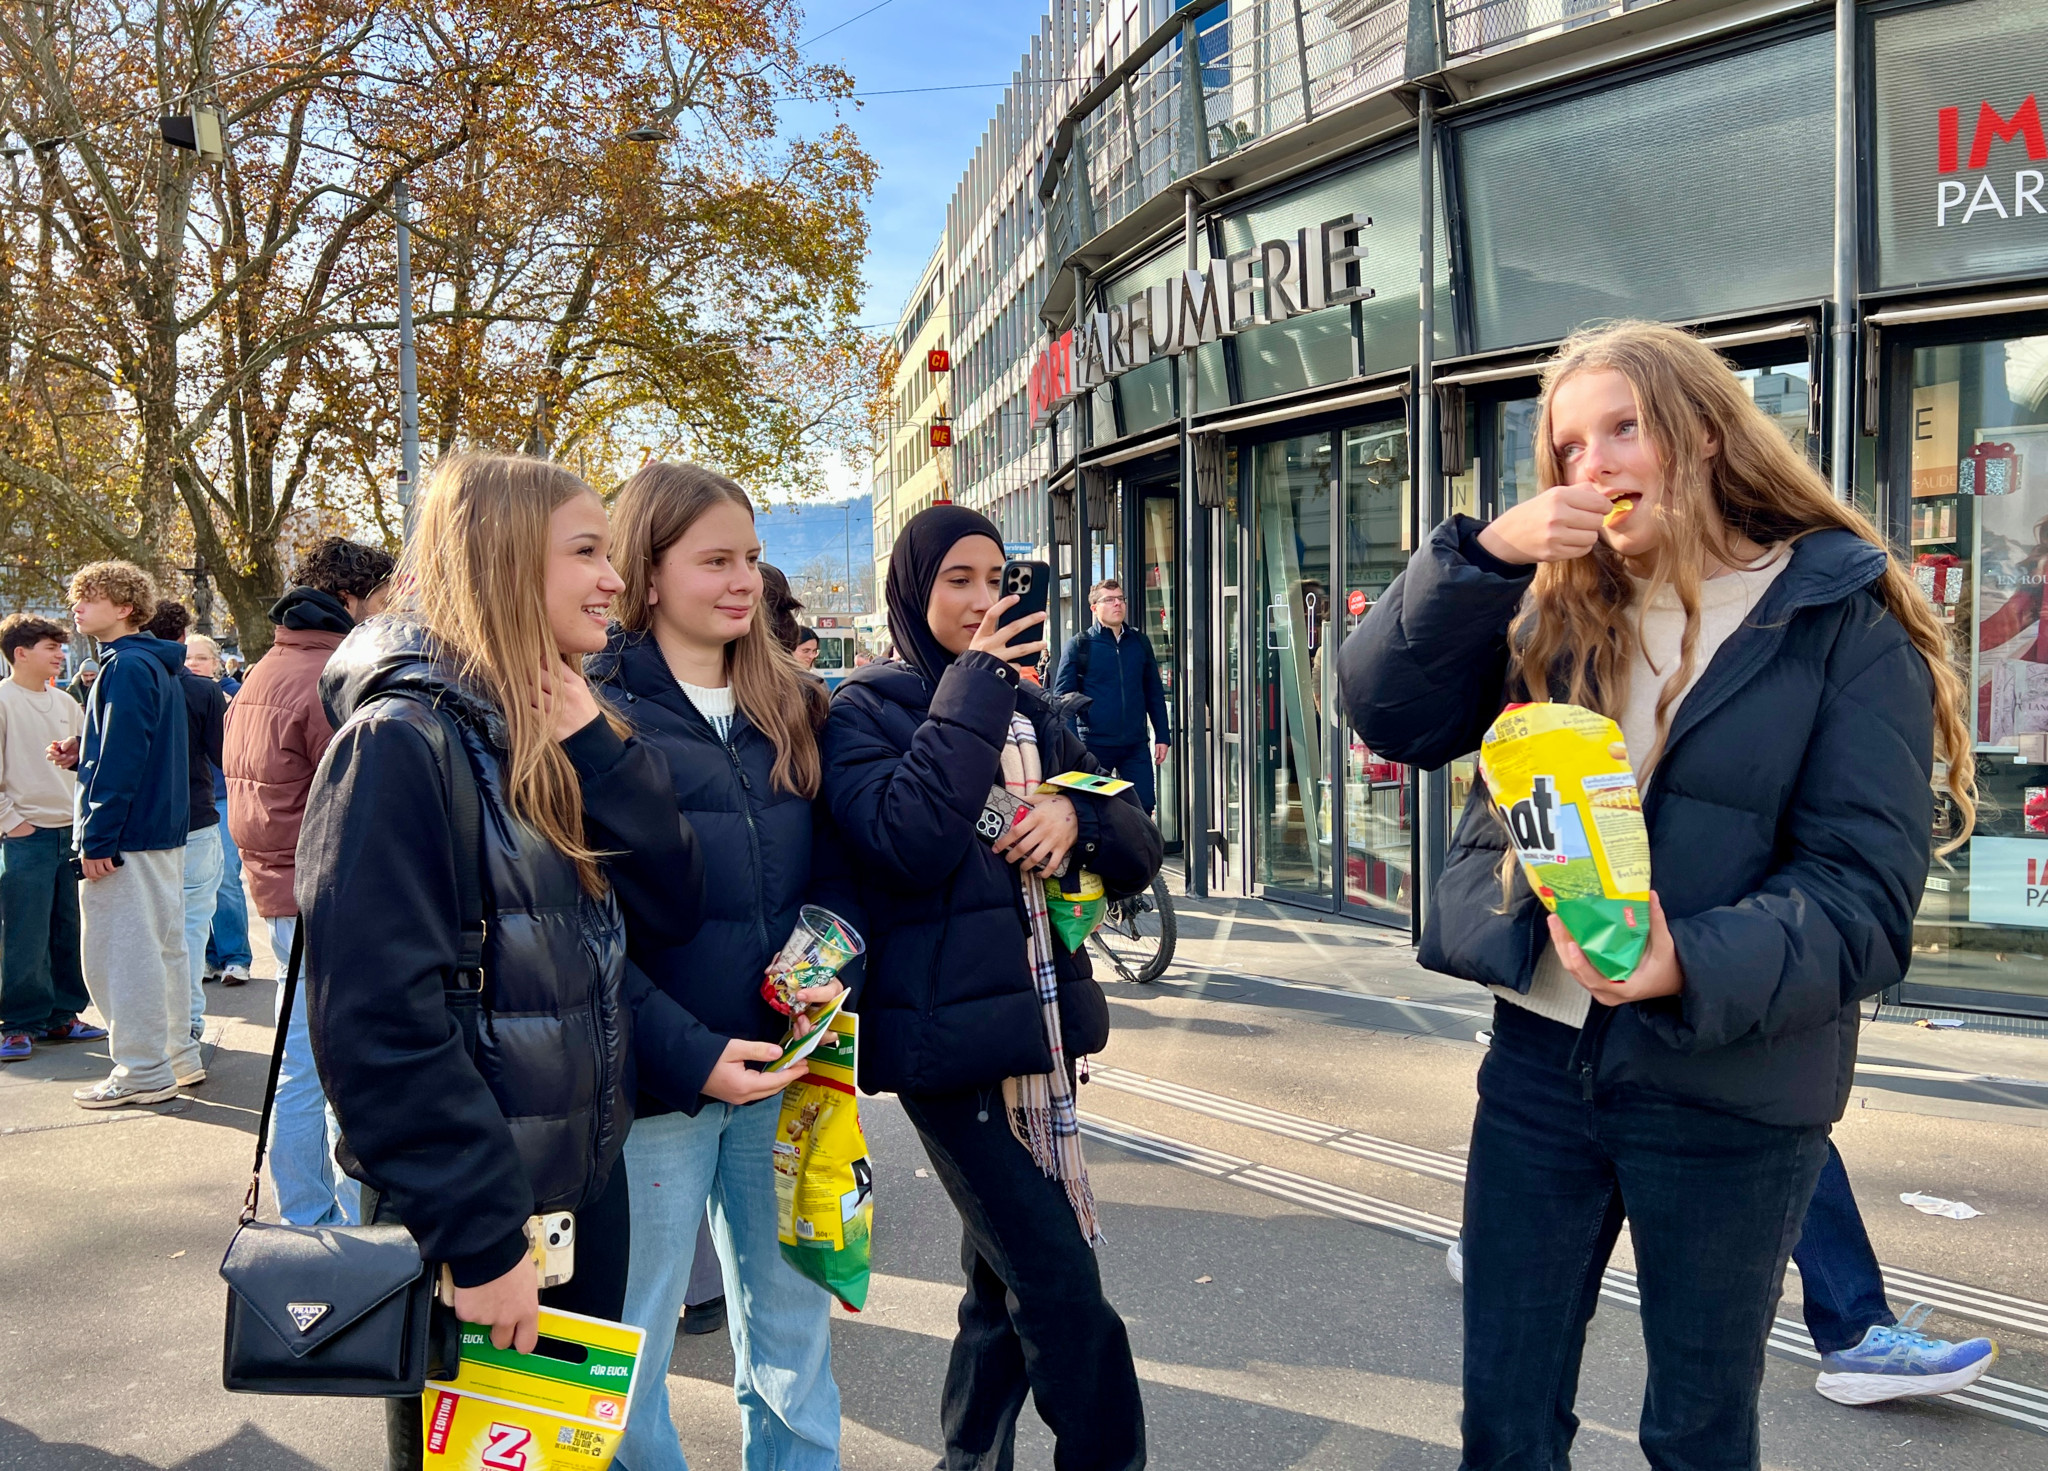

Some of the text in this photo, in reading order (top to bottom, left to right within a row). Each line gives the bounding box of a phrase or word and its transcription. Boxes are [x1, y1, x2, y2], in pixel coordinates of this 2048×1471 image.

[1938, 92, 2048, 173] IM
[1937, 169, 2048, 227] PAR
[1028, 212, 1375, 429] PORT PARFUMERIE
[821, 619, 833, 628] 15
[1499, 777, 1555, 852] at
[2027, 858, 2048, 886] I
[462, 1333, 485, 1345] EUCH.
[590, 1364, 629, 1377] FÜR EUCH.
[434, 1397, 453, 1432] EDITION
[580, 1430, 594, 1441] HOF
